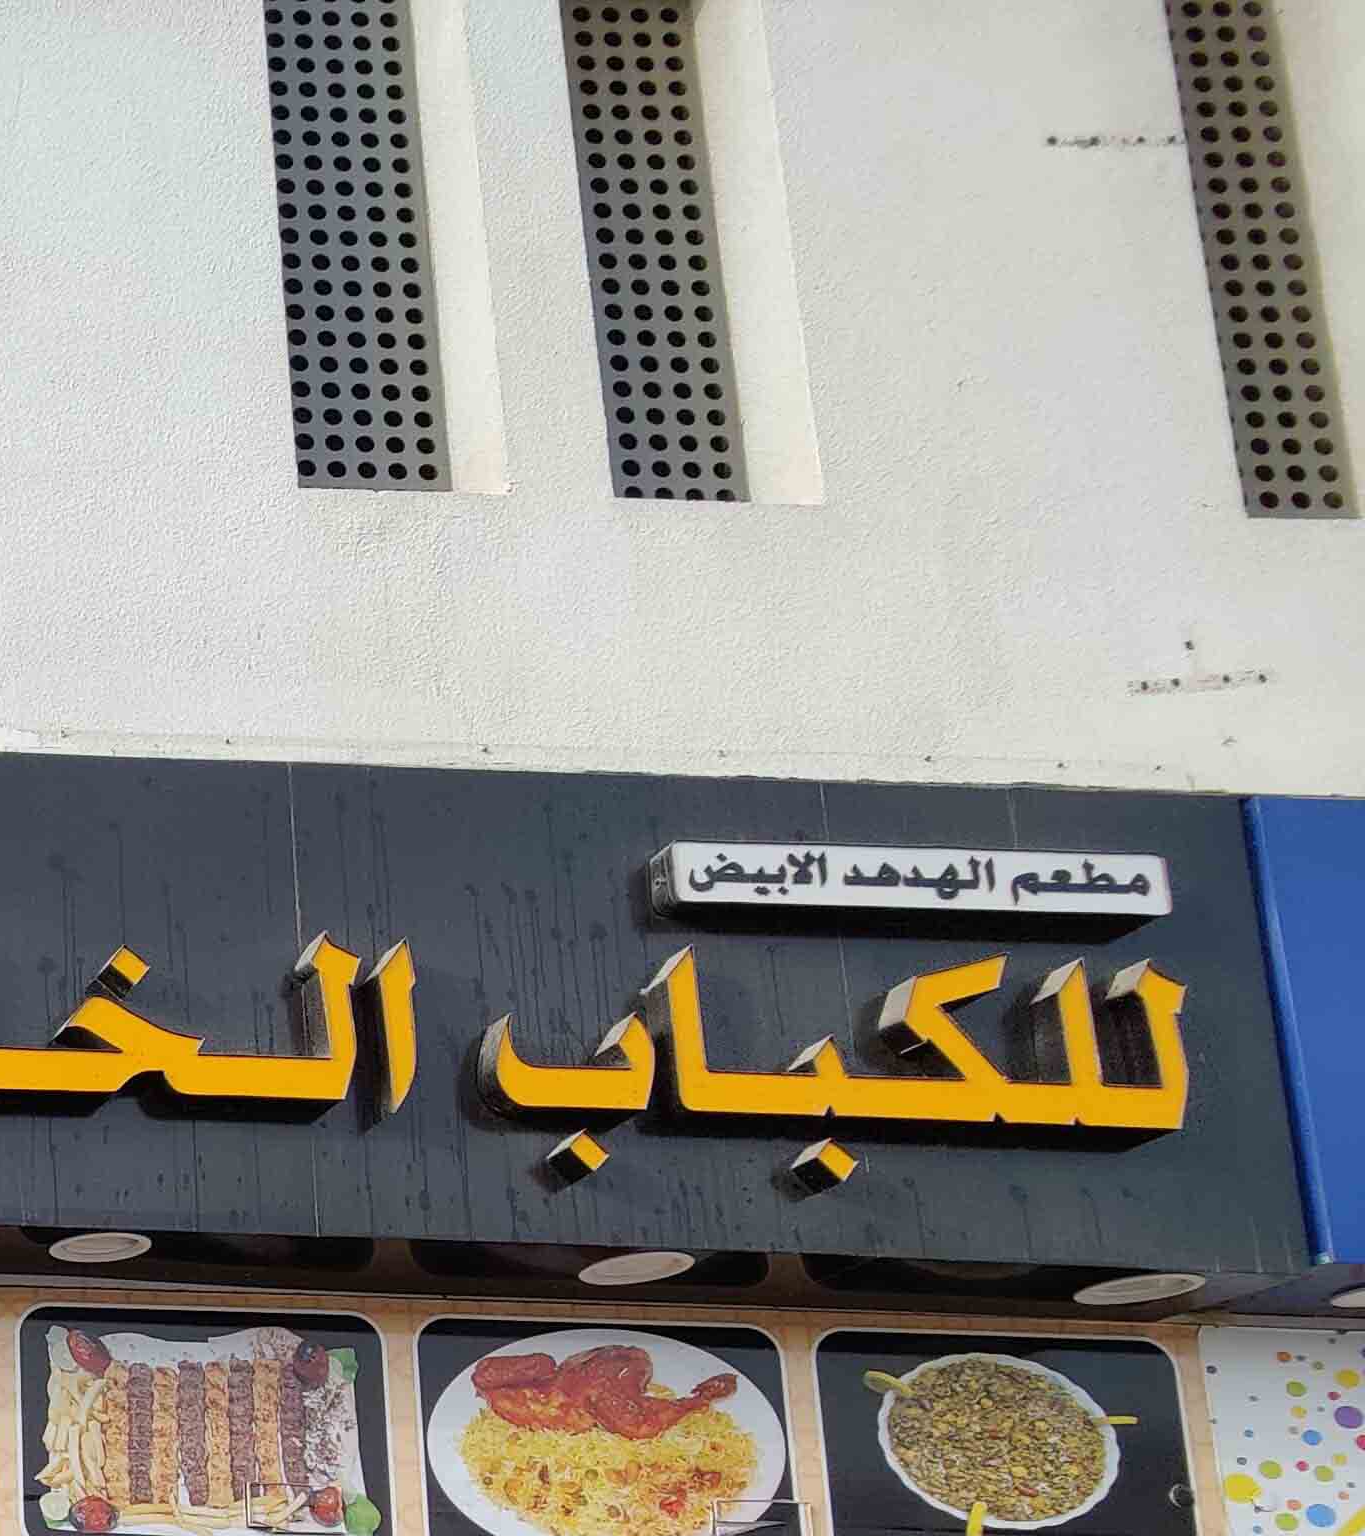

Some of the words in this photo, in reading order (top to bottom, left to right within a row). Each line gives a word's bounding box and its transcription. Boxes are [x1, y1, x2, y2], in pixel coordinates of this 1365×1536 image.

[689, 849, 829, 897] الابيض
[843, 855, 995, 900] الهدهد
[1010, 859, 1152, 904] مطعم
[491, 945, 1188, 1183] للكباب
